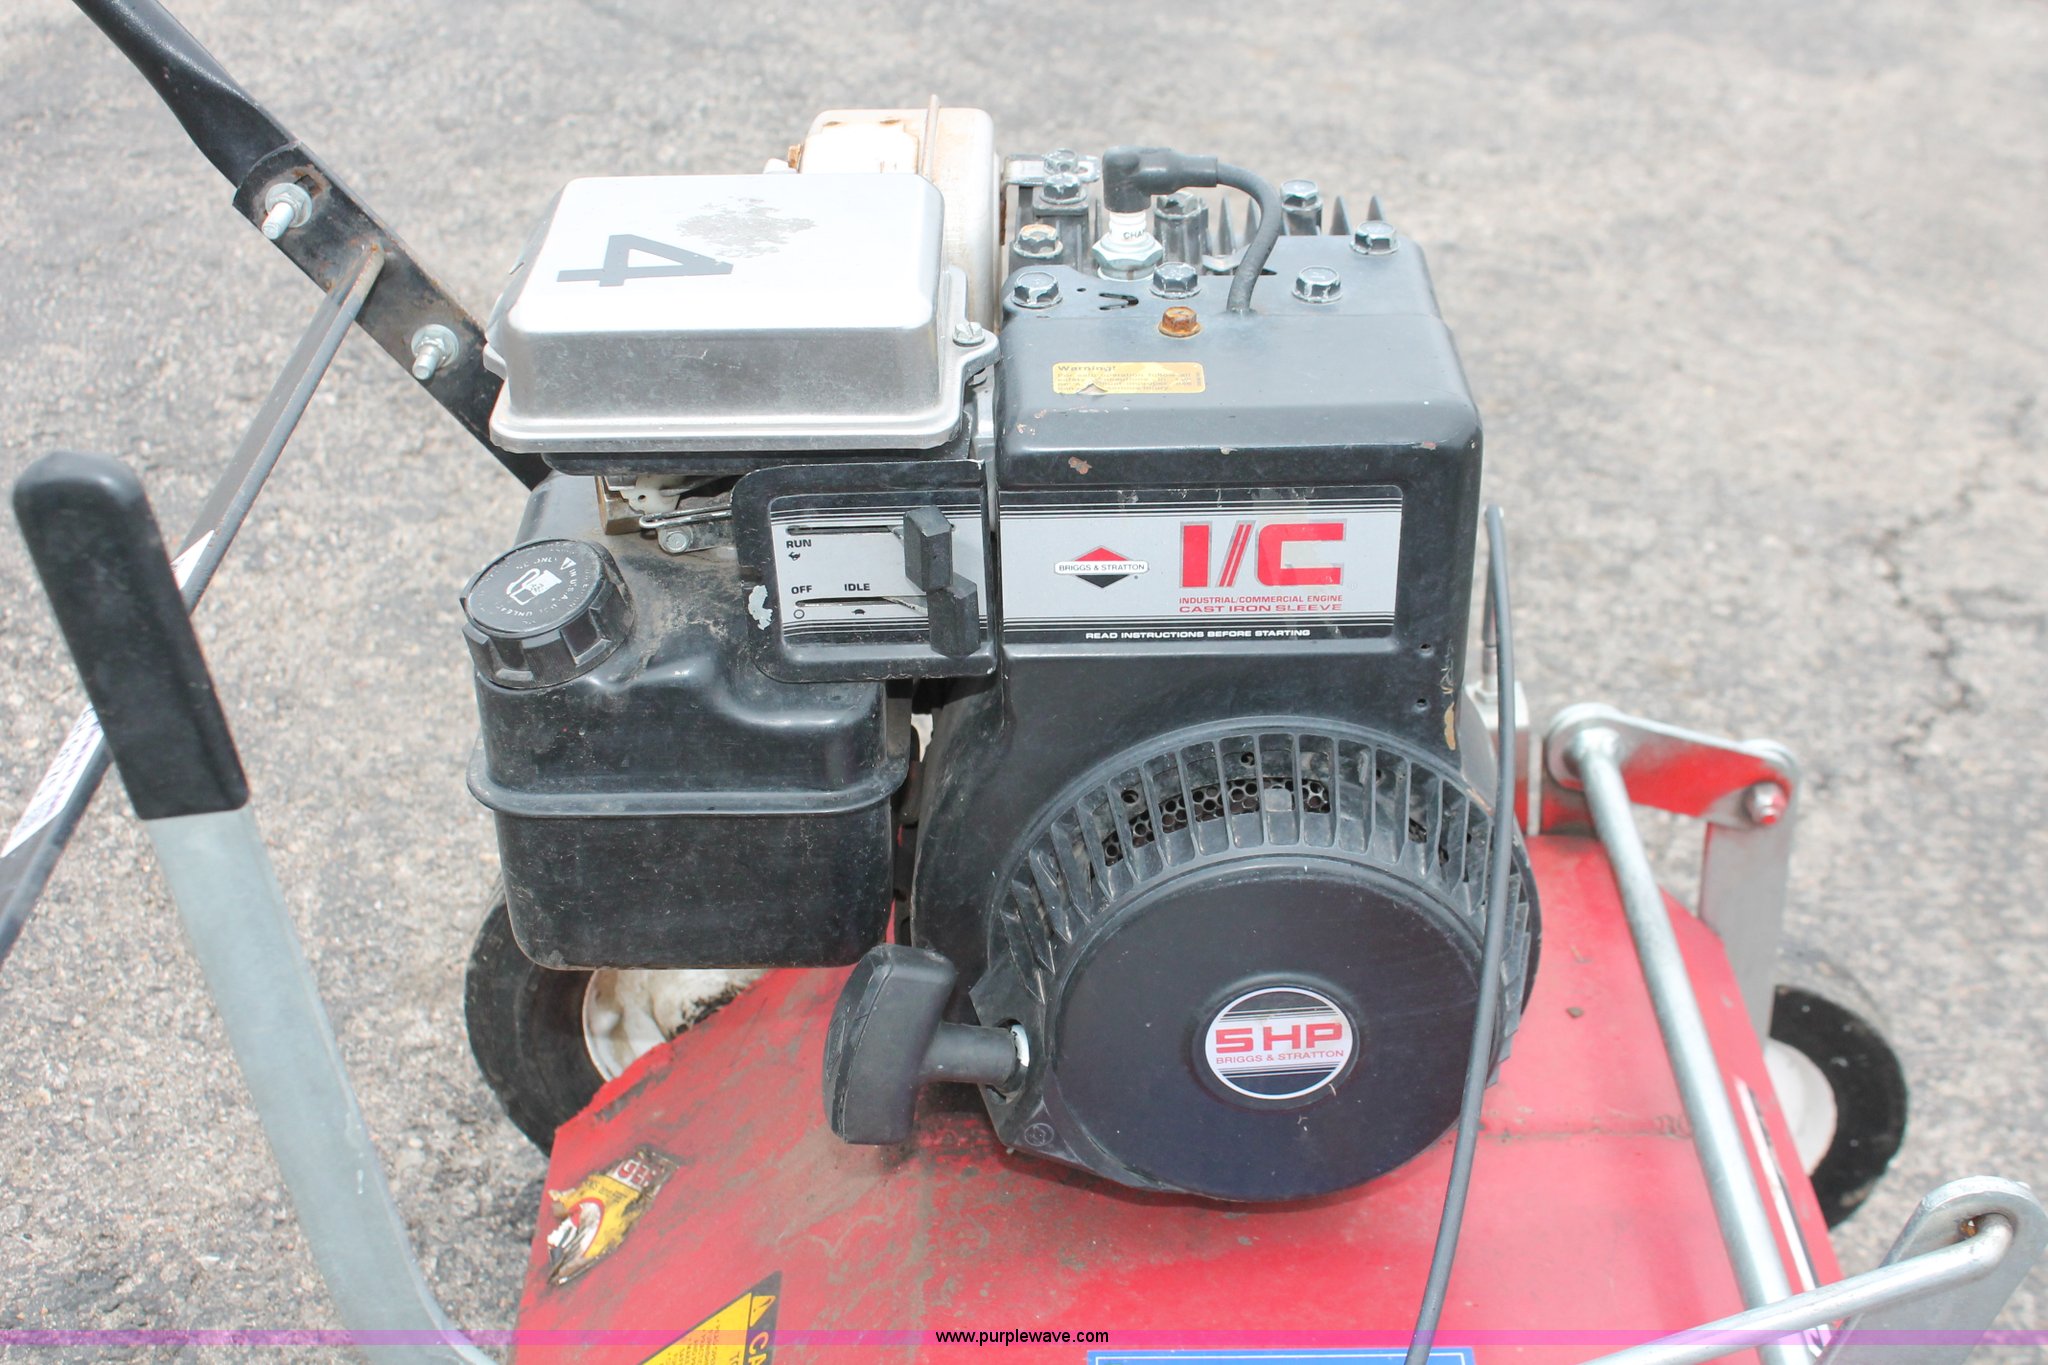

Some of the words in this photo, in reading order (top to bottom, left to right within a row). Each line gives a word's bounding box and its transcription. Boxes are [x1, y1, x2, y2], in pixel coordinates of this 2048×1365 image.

[556, 233, 734, 287] 4
[786, 539, 812, 549] RUN
[1058, 564, 1092, 572] BRIGGS
[1100, 563, 1145, 571] STRATTON
[791, 585, 813, 595] OFF
[844, 583, 871, 592] IDLE
[1179, 595, 1304, 604] INDUSTRIAL/COMMERCIAL
[1307, 594, 1344, 602] ENGINE
[1179, 605, 1225, 613] CAST
[1275, 603, 1343, 611] SLEEVE
[1085, 632, 1118, 640] READ
[1121, 631, 1204, 639] INSTRUCTIONS
[1207, 630, 1252, 638] BEFORE
[1254, 629, 1311, 637] STARTING
[1216, 1054, 1263, 1065] BRIGGS
[1266, 1054, 1275, 1062] &
[1277, 1050, 1344, 1061] STRATTON
